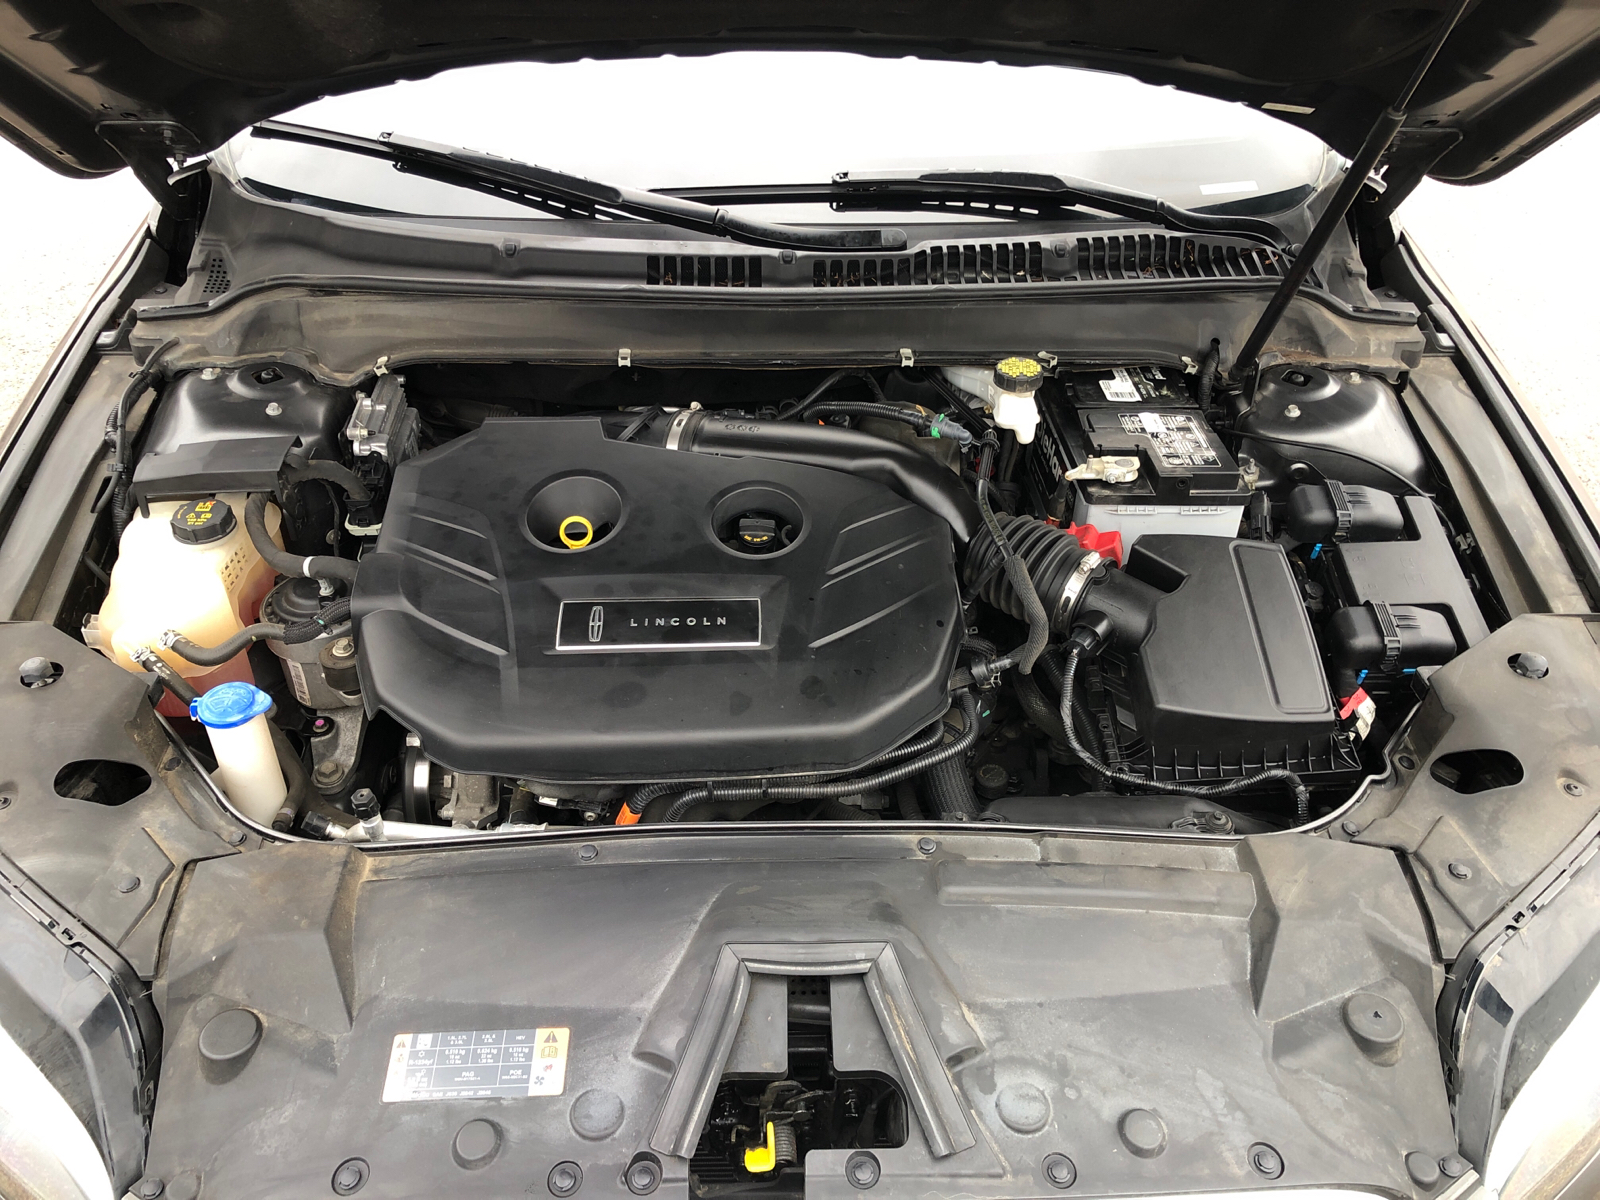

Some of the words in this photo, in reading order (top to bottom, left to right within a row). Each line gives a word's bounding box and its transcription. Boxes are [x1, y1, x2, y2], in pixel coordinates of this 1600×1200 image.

[629, 616, 727, 627] LINCOLN
[459, 1048, 466, 1056] kg
[490, 1047, 498, 1055] kg
[408, 1058, 434, 1067] R-1234yf
